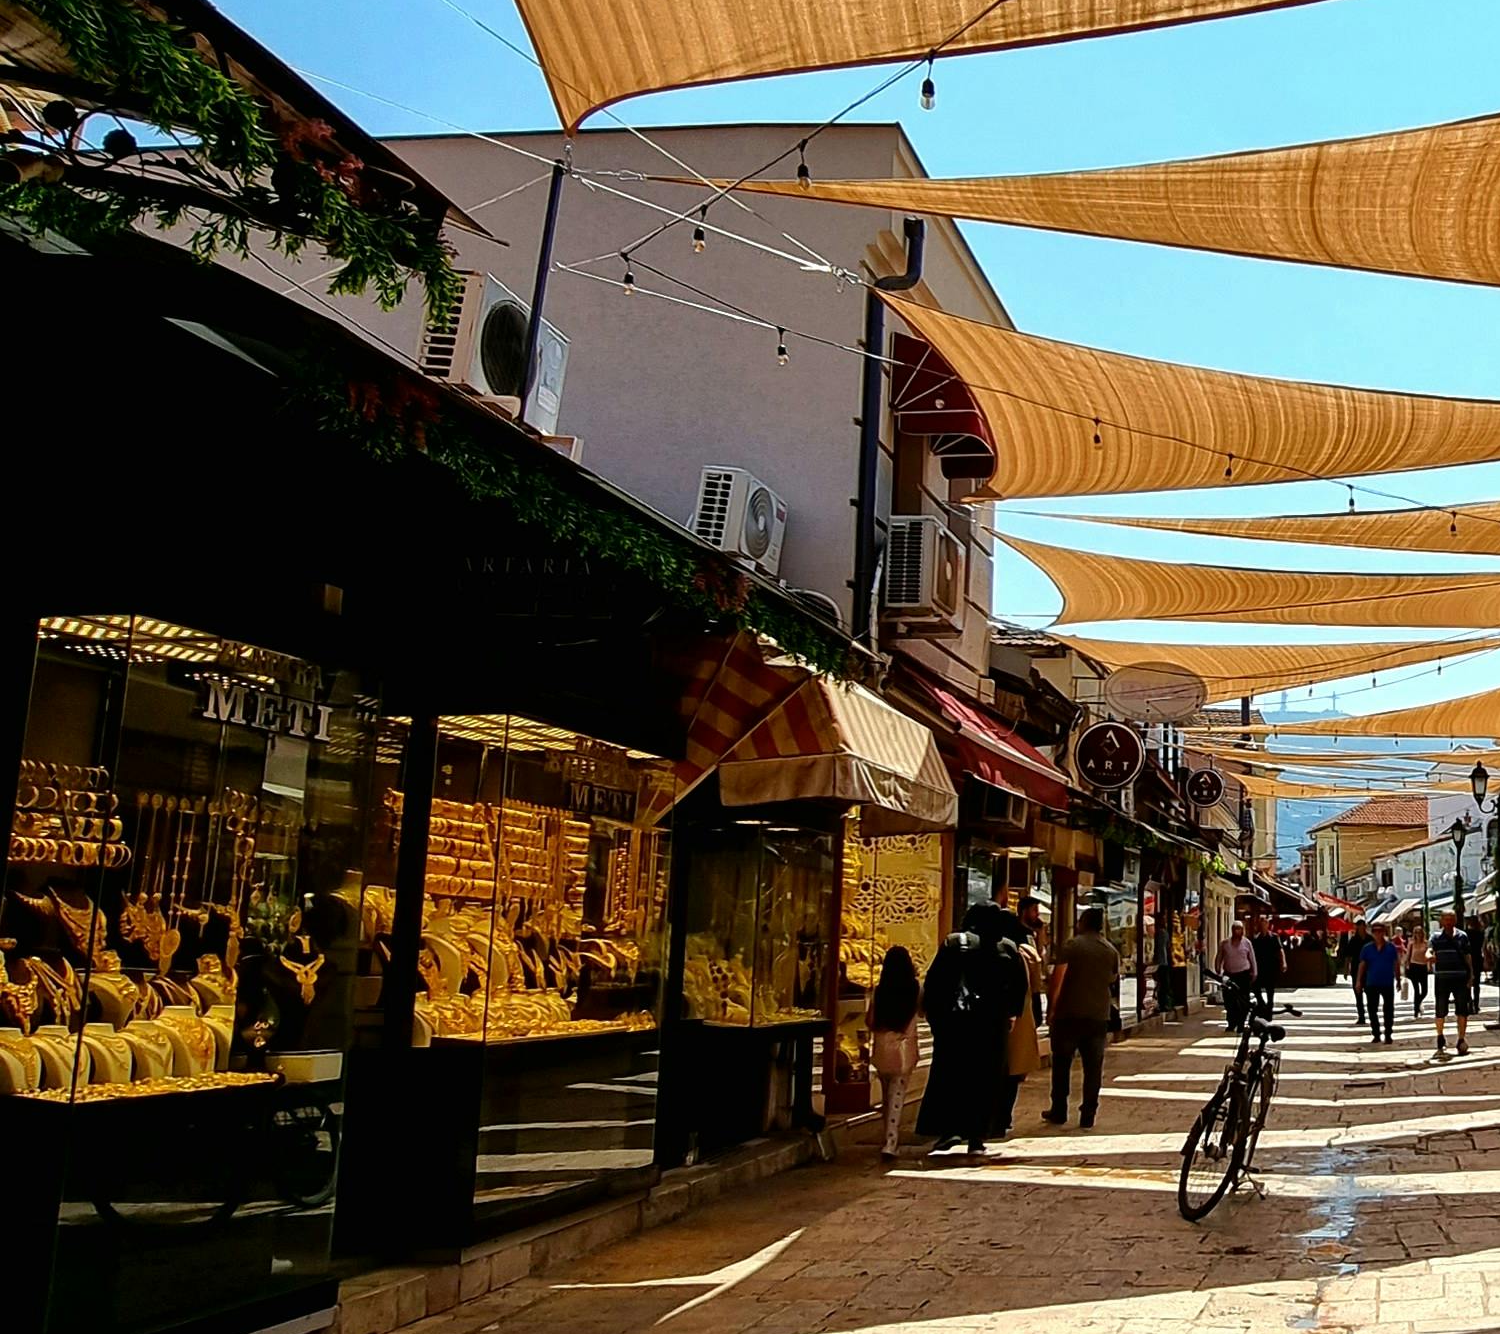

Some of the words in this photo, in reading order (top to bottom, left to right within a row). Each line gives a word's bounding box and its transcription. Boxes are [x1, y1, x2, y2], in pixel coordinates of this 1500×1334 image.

[202, 679, 334, 742] METI
[1086, 760, 1130, 772] ART
[569, 781, 634, 814] METI
